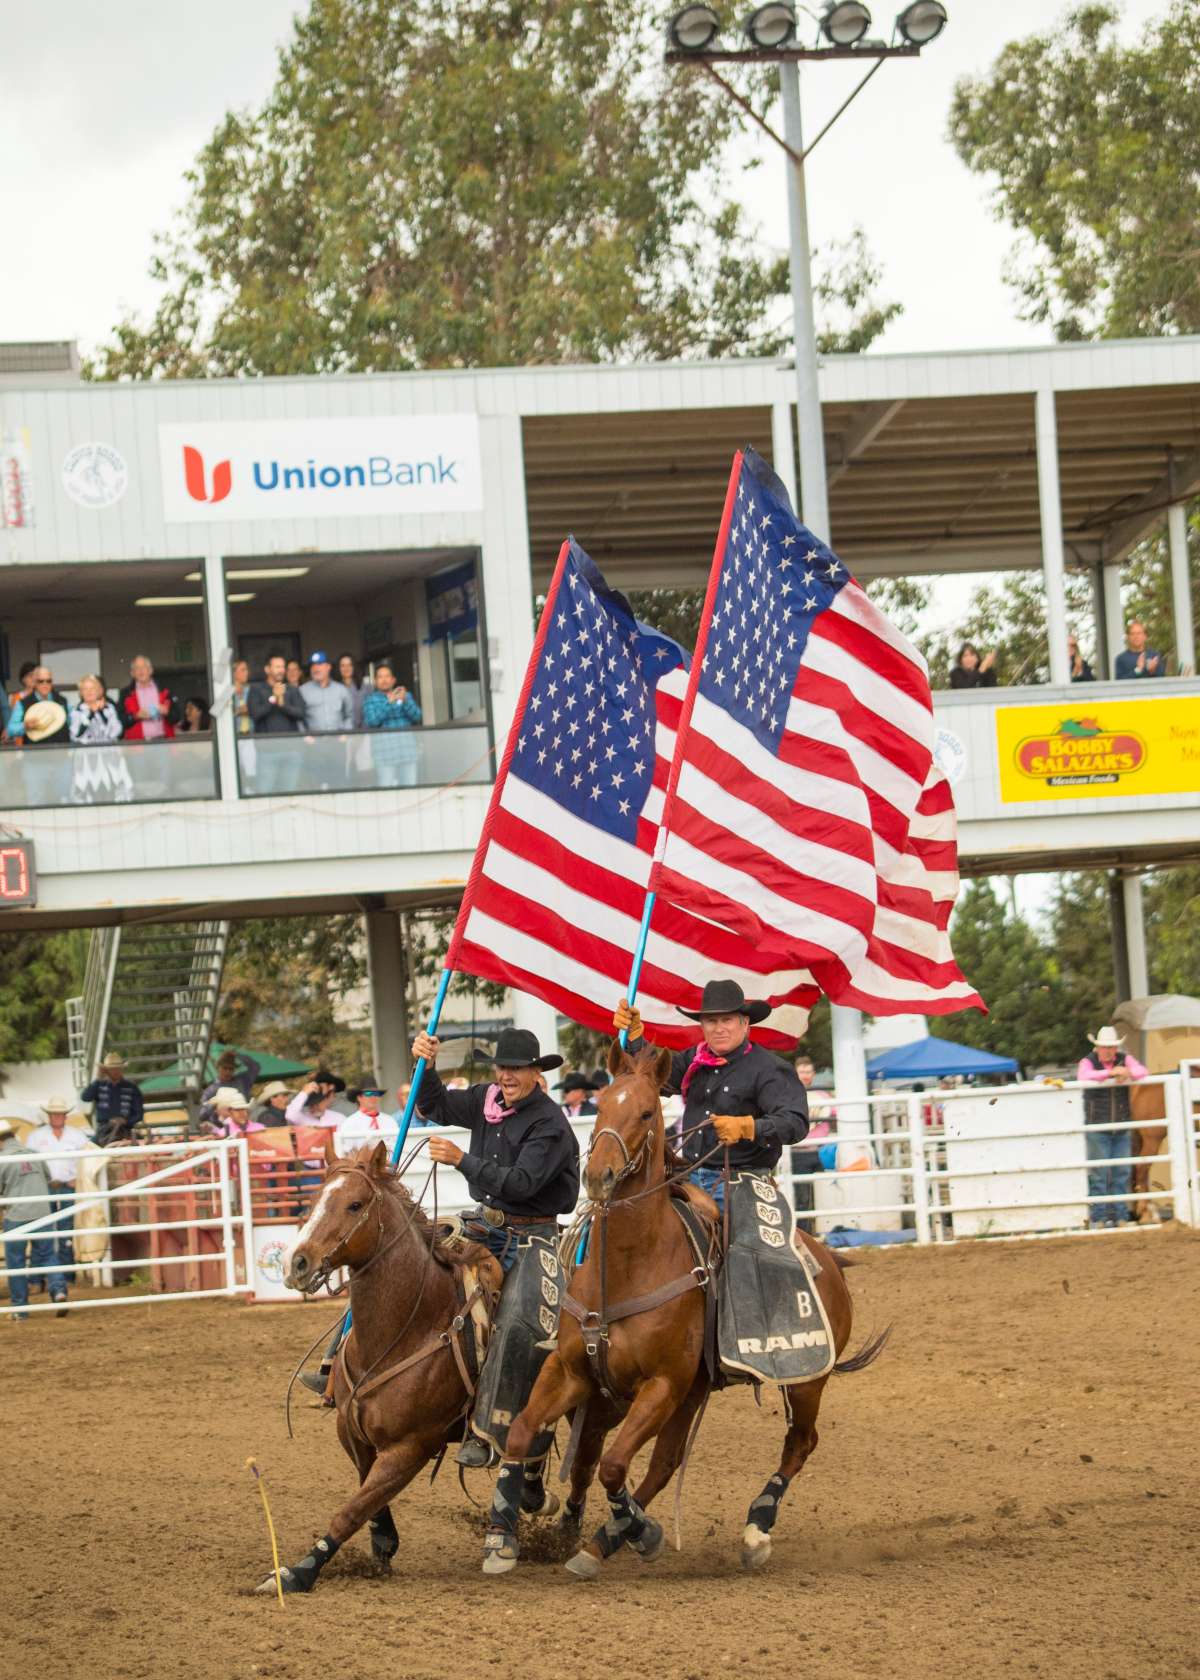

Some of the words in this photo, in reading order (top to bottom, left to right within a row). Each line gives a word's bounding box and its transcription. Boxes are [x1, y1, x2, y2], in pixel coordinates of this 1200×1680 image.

[252, 454, 457, 490] UnionBank
[1049, 737, 1114, 756] BOBBY
[796, 1291, 812, 1318] B
[737, 1330, 828, 1354] RAM
